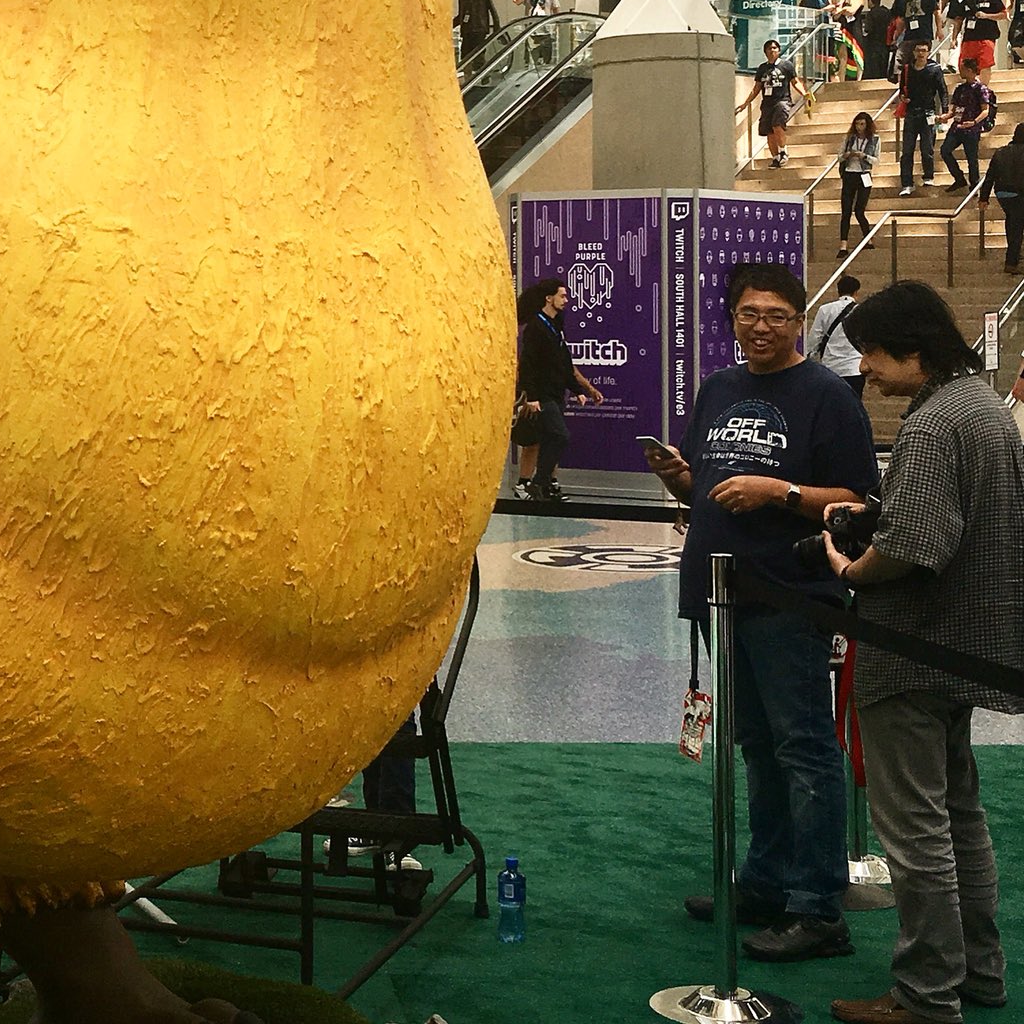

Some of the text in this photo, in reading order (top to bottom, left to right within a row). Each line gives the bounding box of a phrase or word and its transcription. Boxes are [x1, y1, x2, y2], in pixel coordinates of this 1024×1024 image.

[578, 242, 603, 251] BLEED
[575, 253, 606, 261] PURPLE
[675, 228, 686, 417] TWITCH SOUTH HALL 1401 twitch.tv/e3
[568, 340, 628, 366] witch
[593, 376, 601, 385] of
[726, 417, 766, 429] OFF
[706, 427, 787, 449] WORLD
